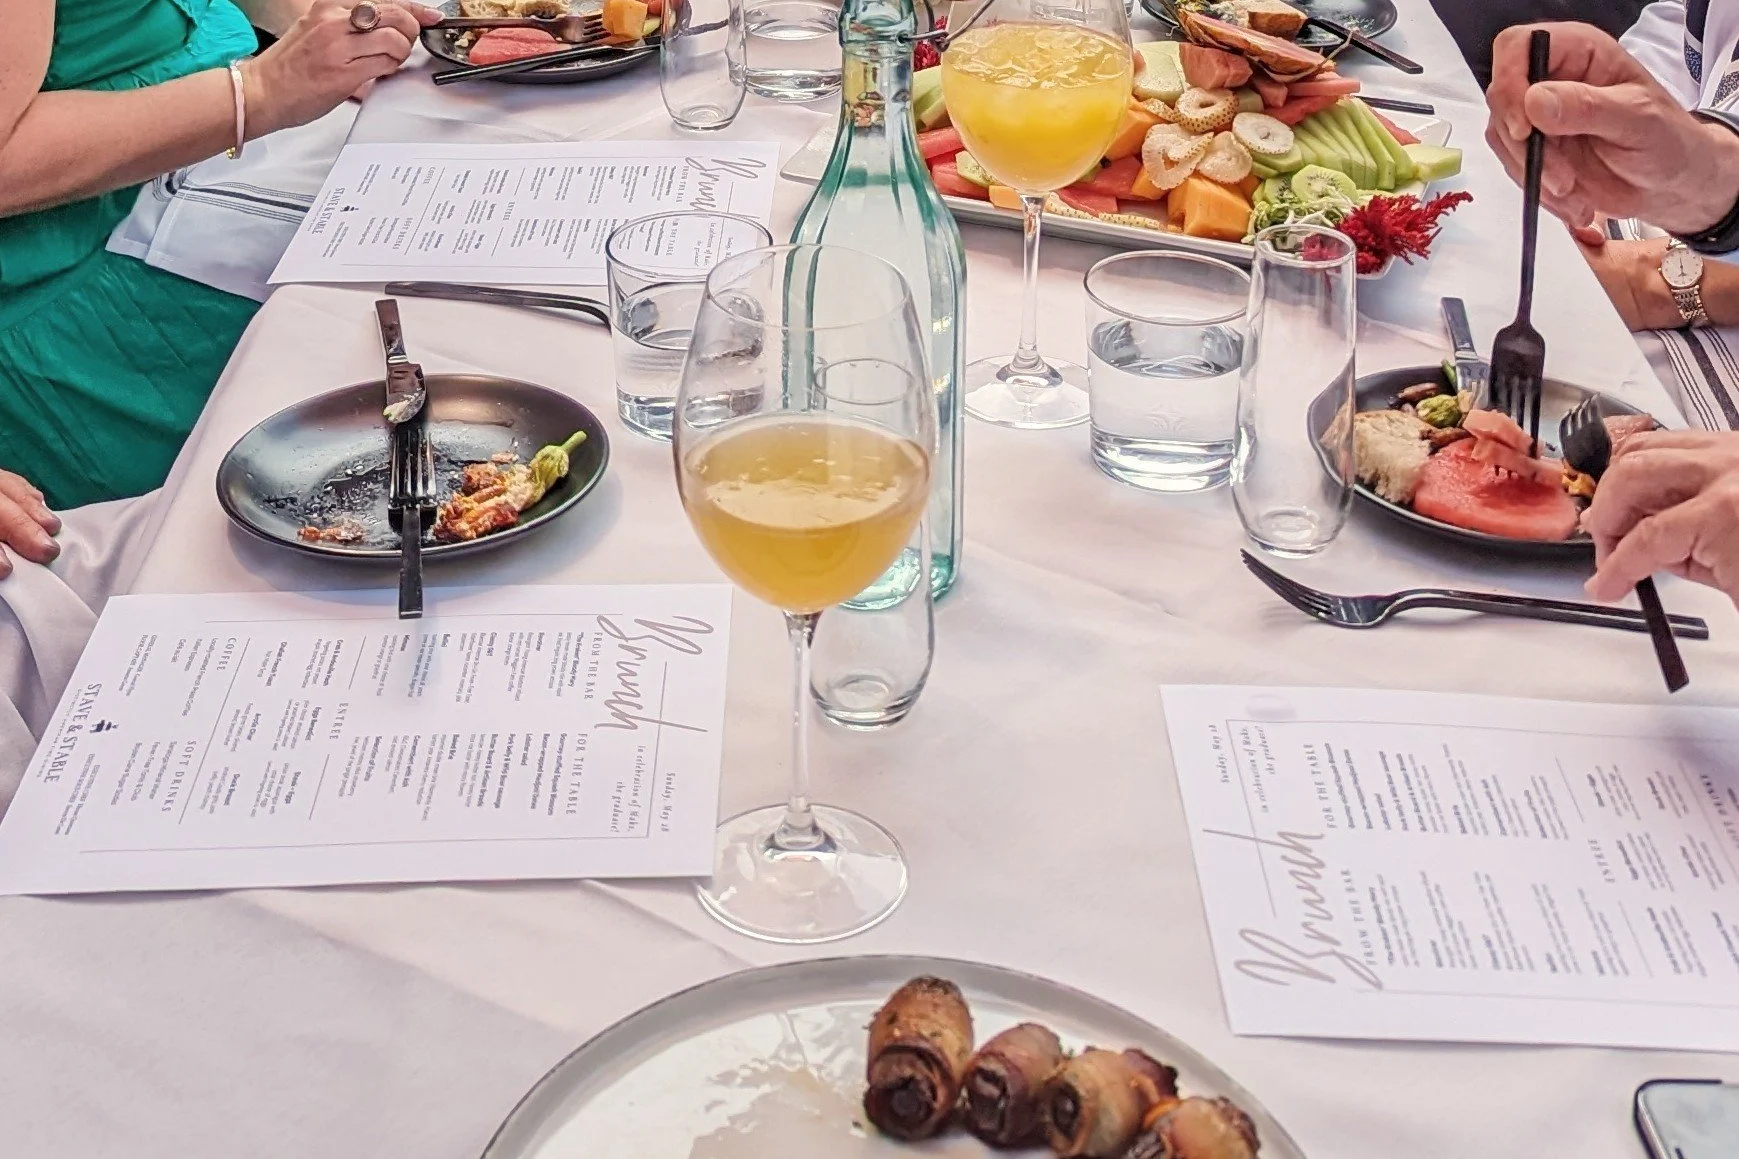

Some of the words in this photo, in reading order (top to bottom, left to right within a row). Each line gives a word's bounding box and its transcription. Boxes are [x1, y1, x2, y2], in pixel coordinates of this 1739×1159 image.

[311, 212, 332, 234] STABLE
[216, 637, 237, 671] COFFEE
[591, 631, 603, 656] FROM
[587, 660, 599, 678] THE
[594, 614, 714, 732] Brunch
[72, 683, 102, 722] STAVE
[583, 681, 596, 700] BAR
[66, 724, 83, 734] &
[328, 702, 349, 739] ENTREE
[178, 740, 197, 766] SOFT
[575, 733, 588, 752] FOR
[43, 736, 78, 783] STABLE
[571, 756, 584, 777] THE
[1302, 743, 1321, 775] TABLE
[631, 755, 646, 797] celebration
[660, 772, 676, 801] Sunday,
[161, 771, 185, 812] DRINKS
[565, 781, 581, 815] TABLE
[627, 799, 642, 808] of
[1313, 780, 1329, 801] THE
[659, 805, 673, 820] May
[1321, 806, 1337, 829] FOR
[1202, 828, 1384, 990] Brunch
